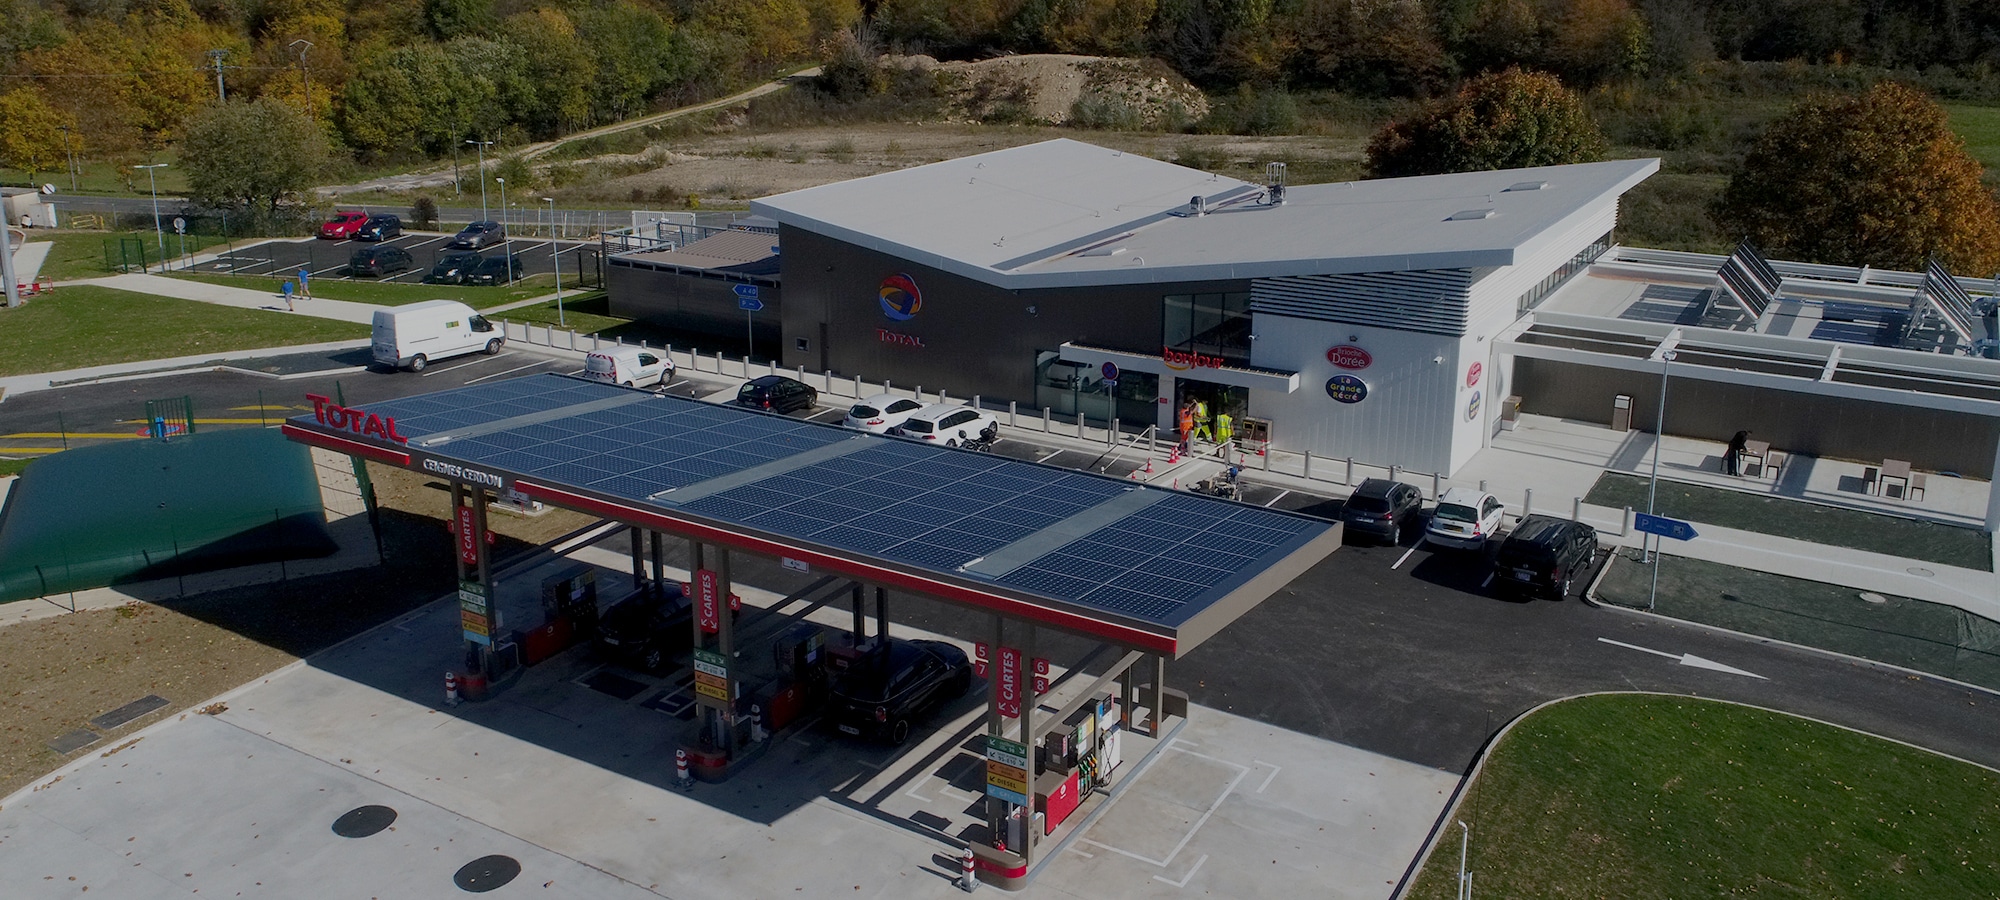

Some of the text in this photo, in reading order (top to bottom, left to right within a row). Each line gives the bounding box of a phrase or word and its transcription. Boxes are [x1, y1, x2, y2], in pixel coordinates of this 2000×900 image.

[876, 328, 926, 348] TOTAL
[1163, 346, 1225, 369] bonjour
[1337, 347, 1363, 358] Brioche
[1332, 353, 1365, 367] Dorée
[1330, 383, 1362, 394] Grande
[1332, 391, 1359, 401] Récré
[306, 393, 408, 443] TOTAL
[462, 468, 502, 489] CERDON
[461, 510, 472, 549] CARTES
[487, 532, 493, 542] 2
[685, 586, 691, 595] 3
[702, 573, 713, 618] CARTES
[730, 599, 737, 608] 4
[979, 646, 986, 657] 5
[978, 664, 985, 675] 7
[1037, 661, 1045, 673] 6
[1002, 652, 1014, 701] CARTES
[1036, 679, 1044, 691] 8
[997, 778, 1017, 789] DIESEL
